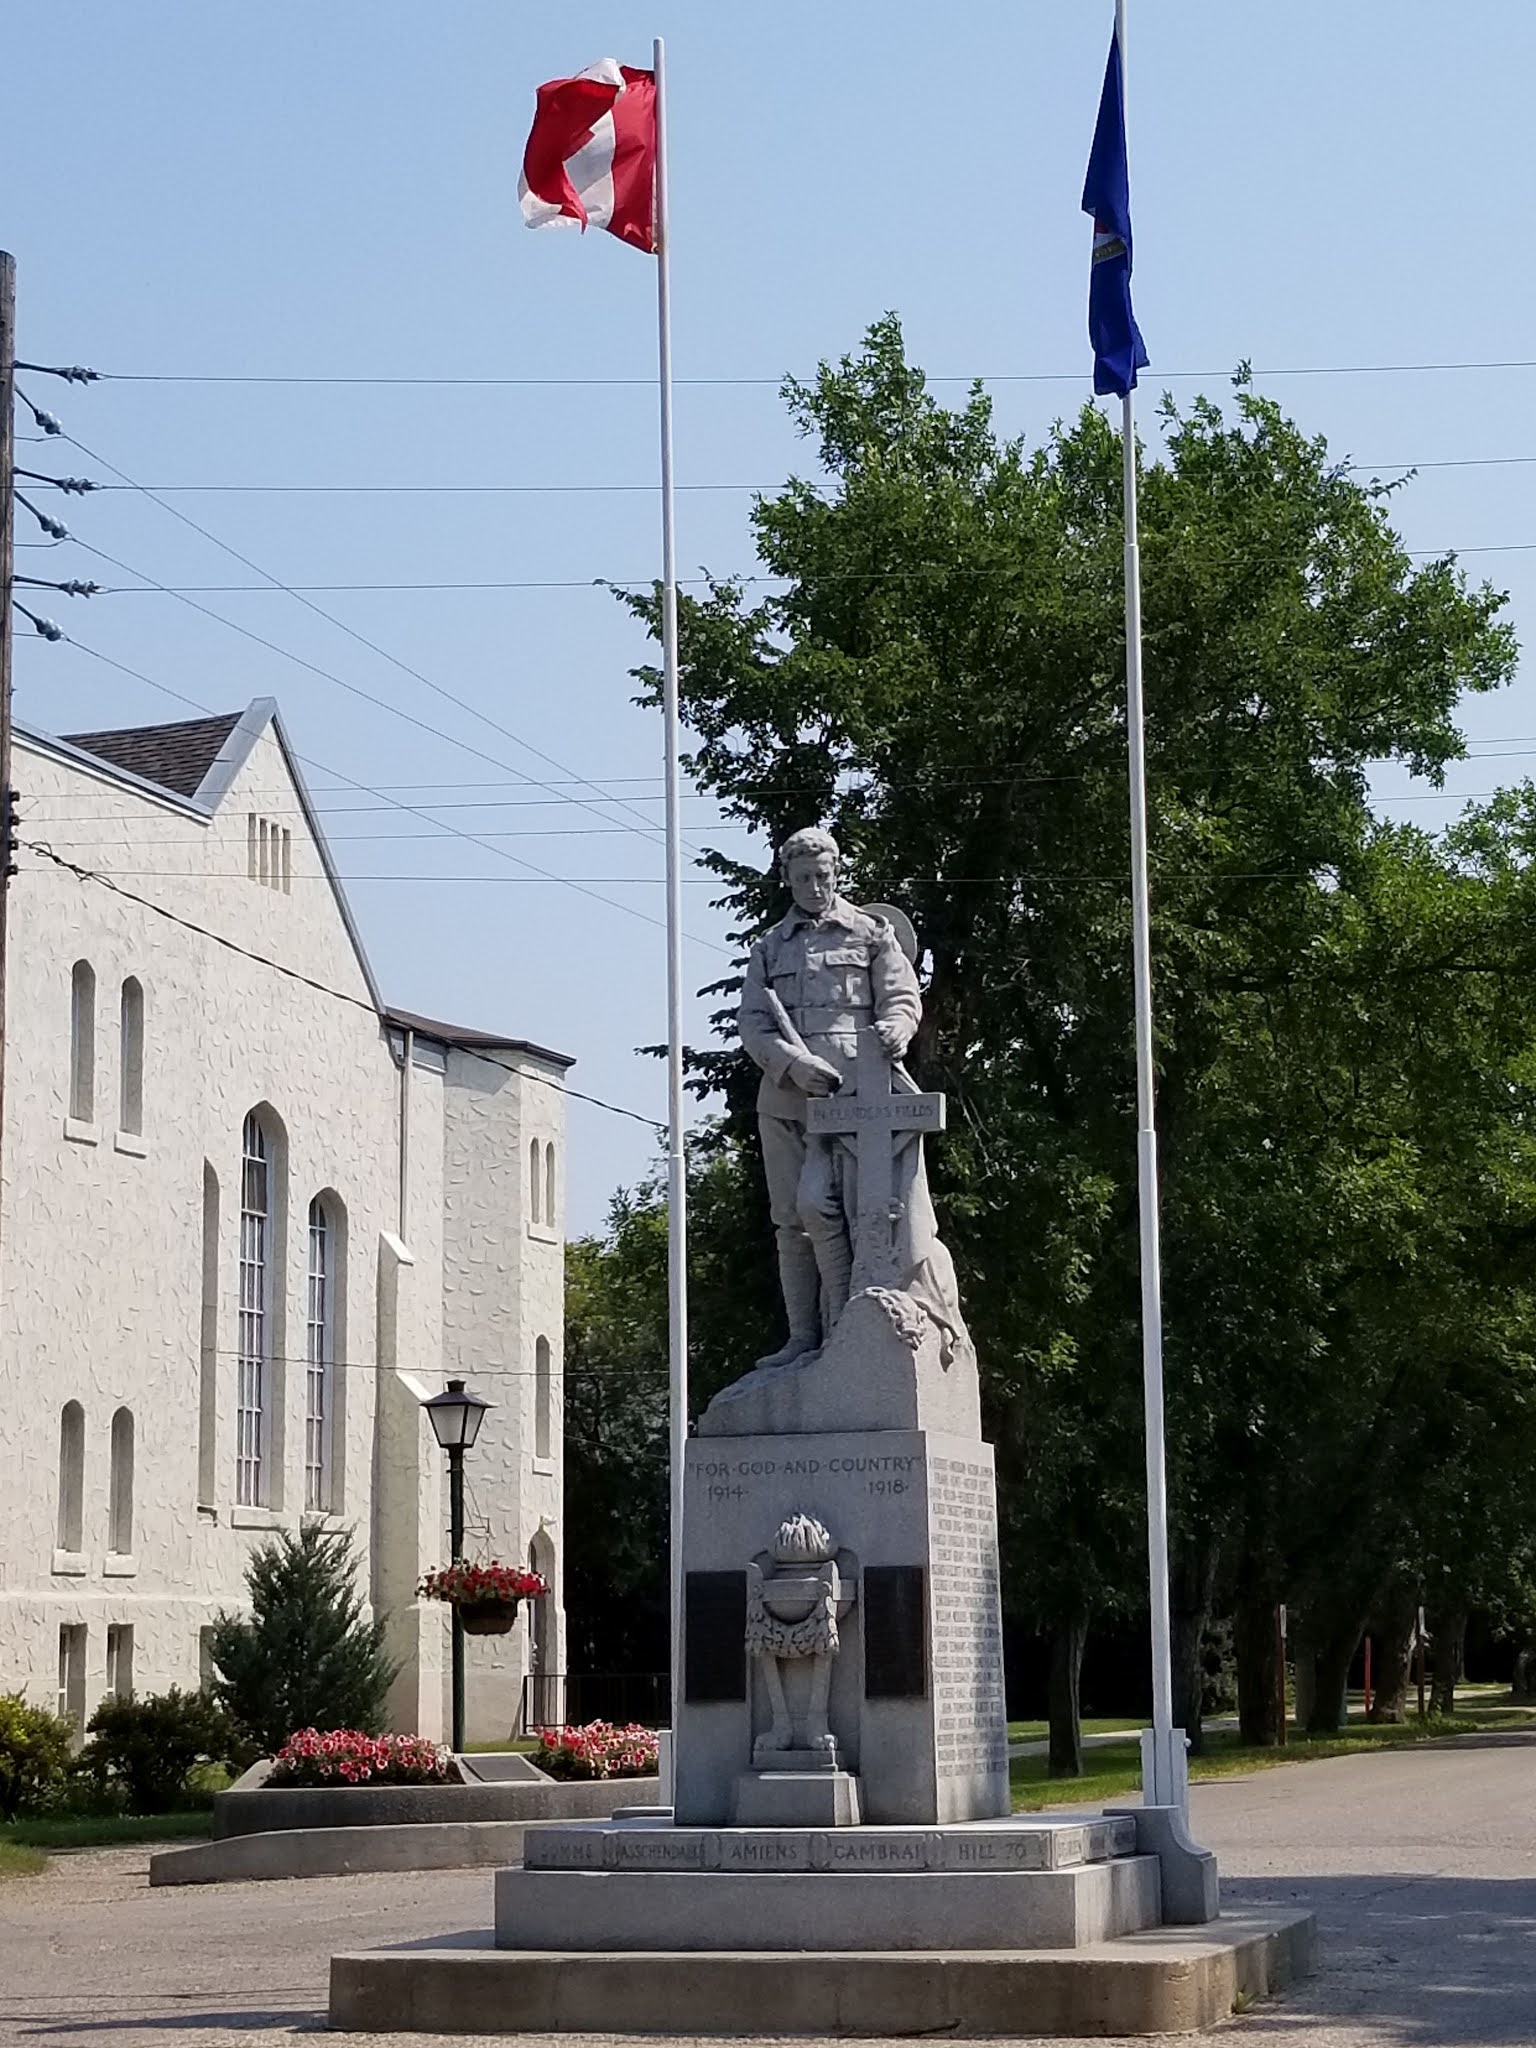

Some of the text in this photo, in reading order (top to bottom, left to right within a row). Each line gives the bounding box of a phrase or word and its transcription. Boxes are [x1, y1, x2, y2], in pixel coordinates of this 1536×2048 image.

[738, 1460, 776, 1476] GOD
[784, 1459, 820, 1475] AND
[731, 1843, 798, 1861] AMIENS
[834, 1843, 920, 1860] CAMBRAI
[959, 1843, 996, 1860] HILL
